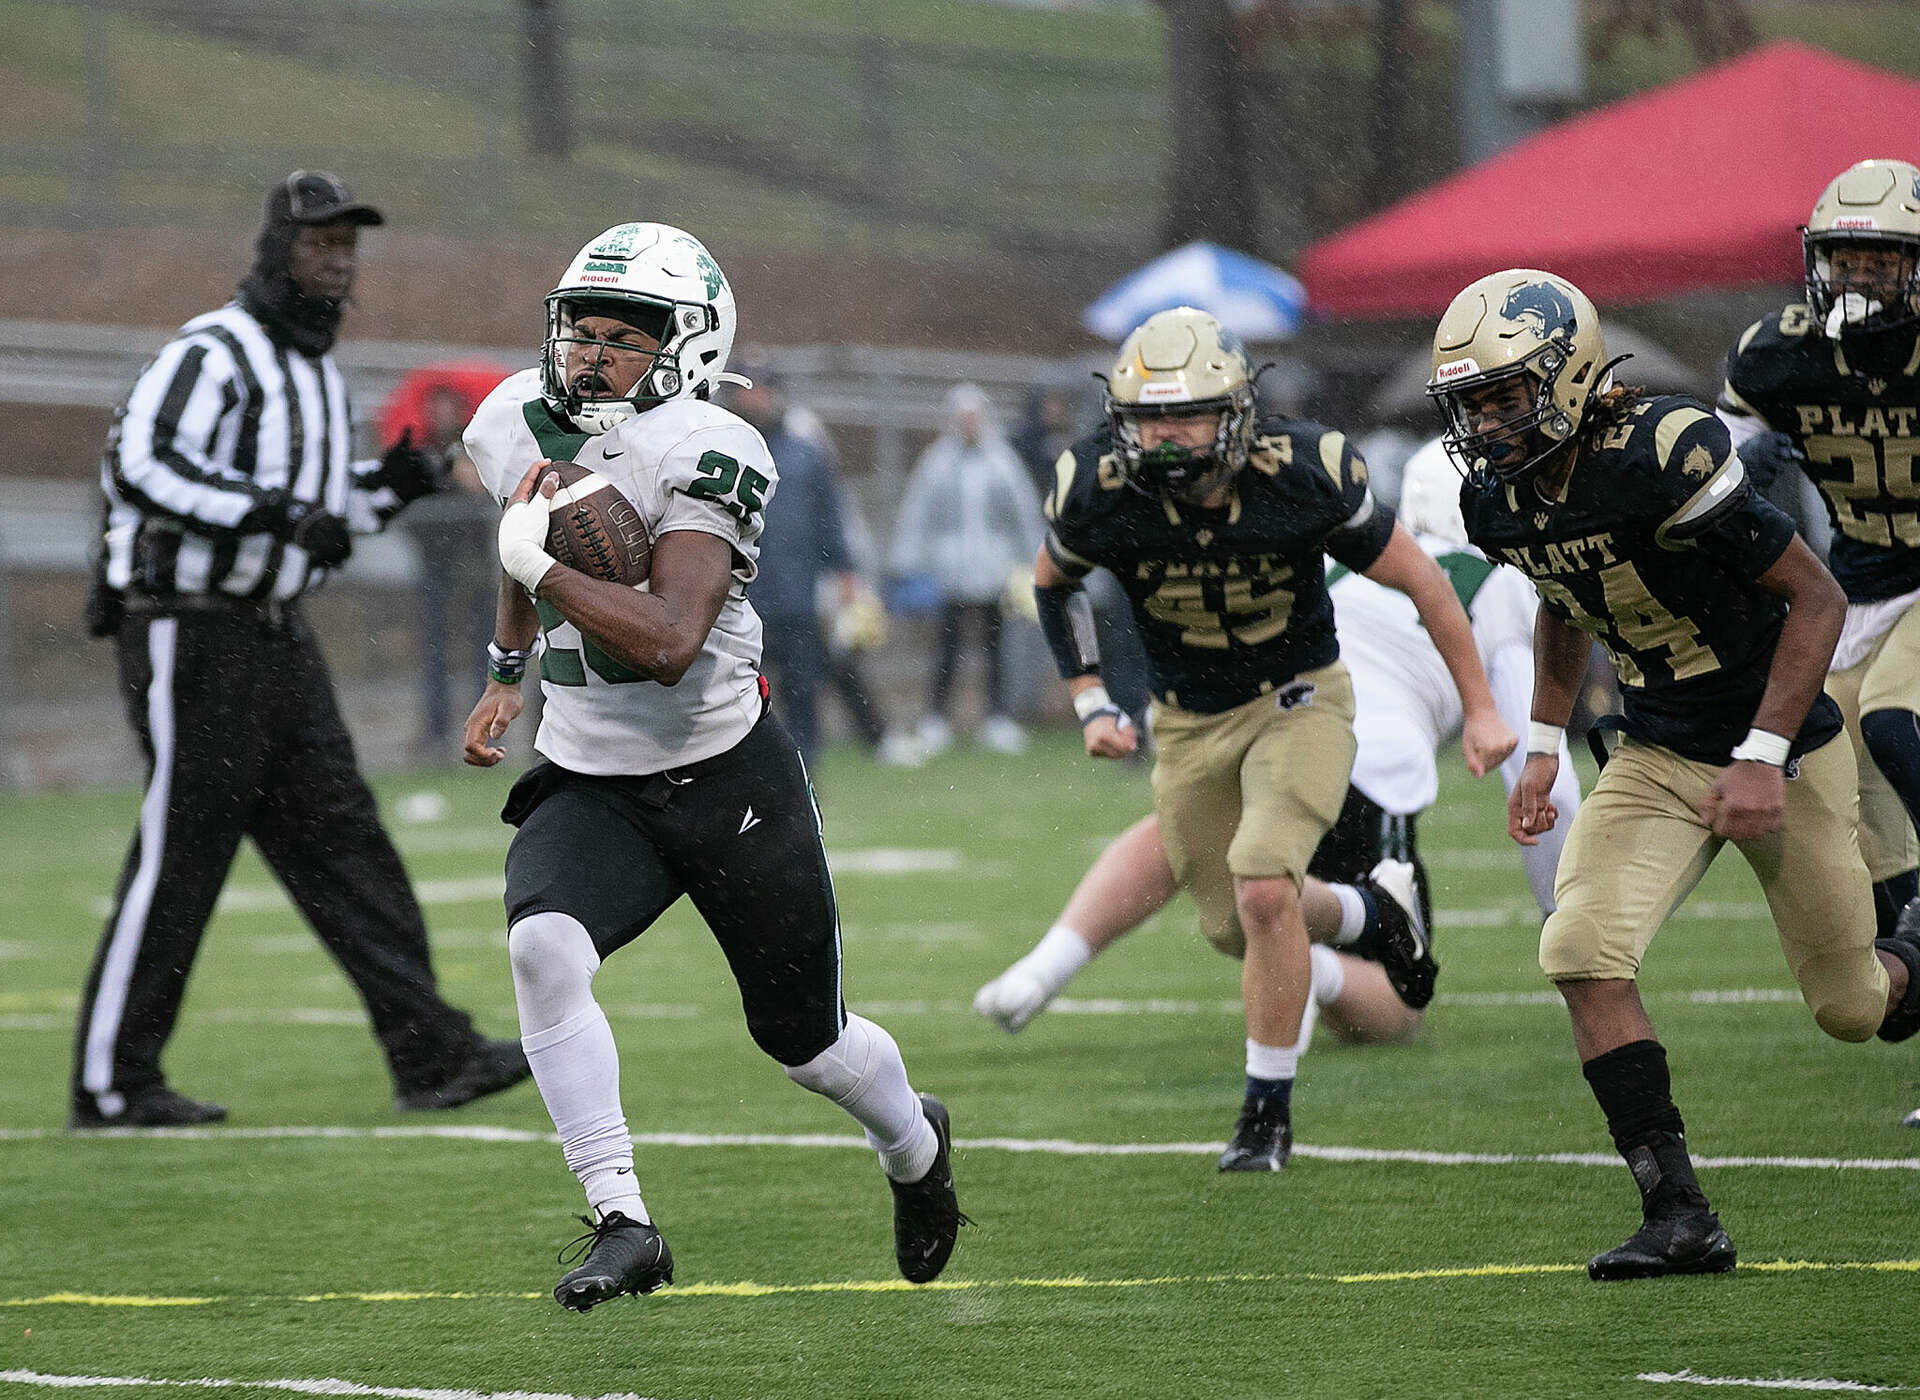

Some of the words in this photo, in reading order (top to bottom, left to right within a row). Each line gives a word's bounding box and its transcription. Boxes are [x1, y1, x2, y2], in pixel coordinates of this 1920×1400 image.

[580, 274, 619, 284] Riddell
[1439, 362, 1470, 378] Riddell
[687, 449, 770, 526] 25
[1500, 532, 1617, 577] PLATT
[1143, 577, 1296, 649] 45
[1529, 560, 1722, 688] 24
